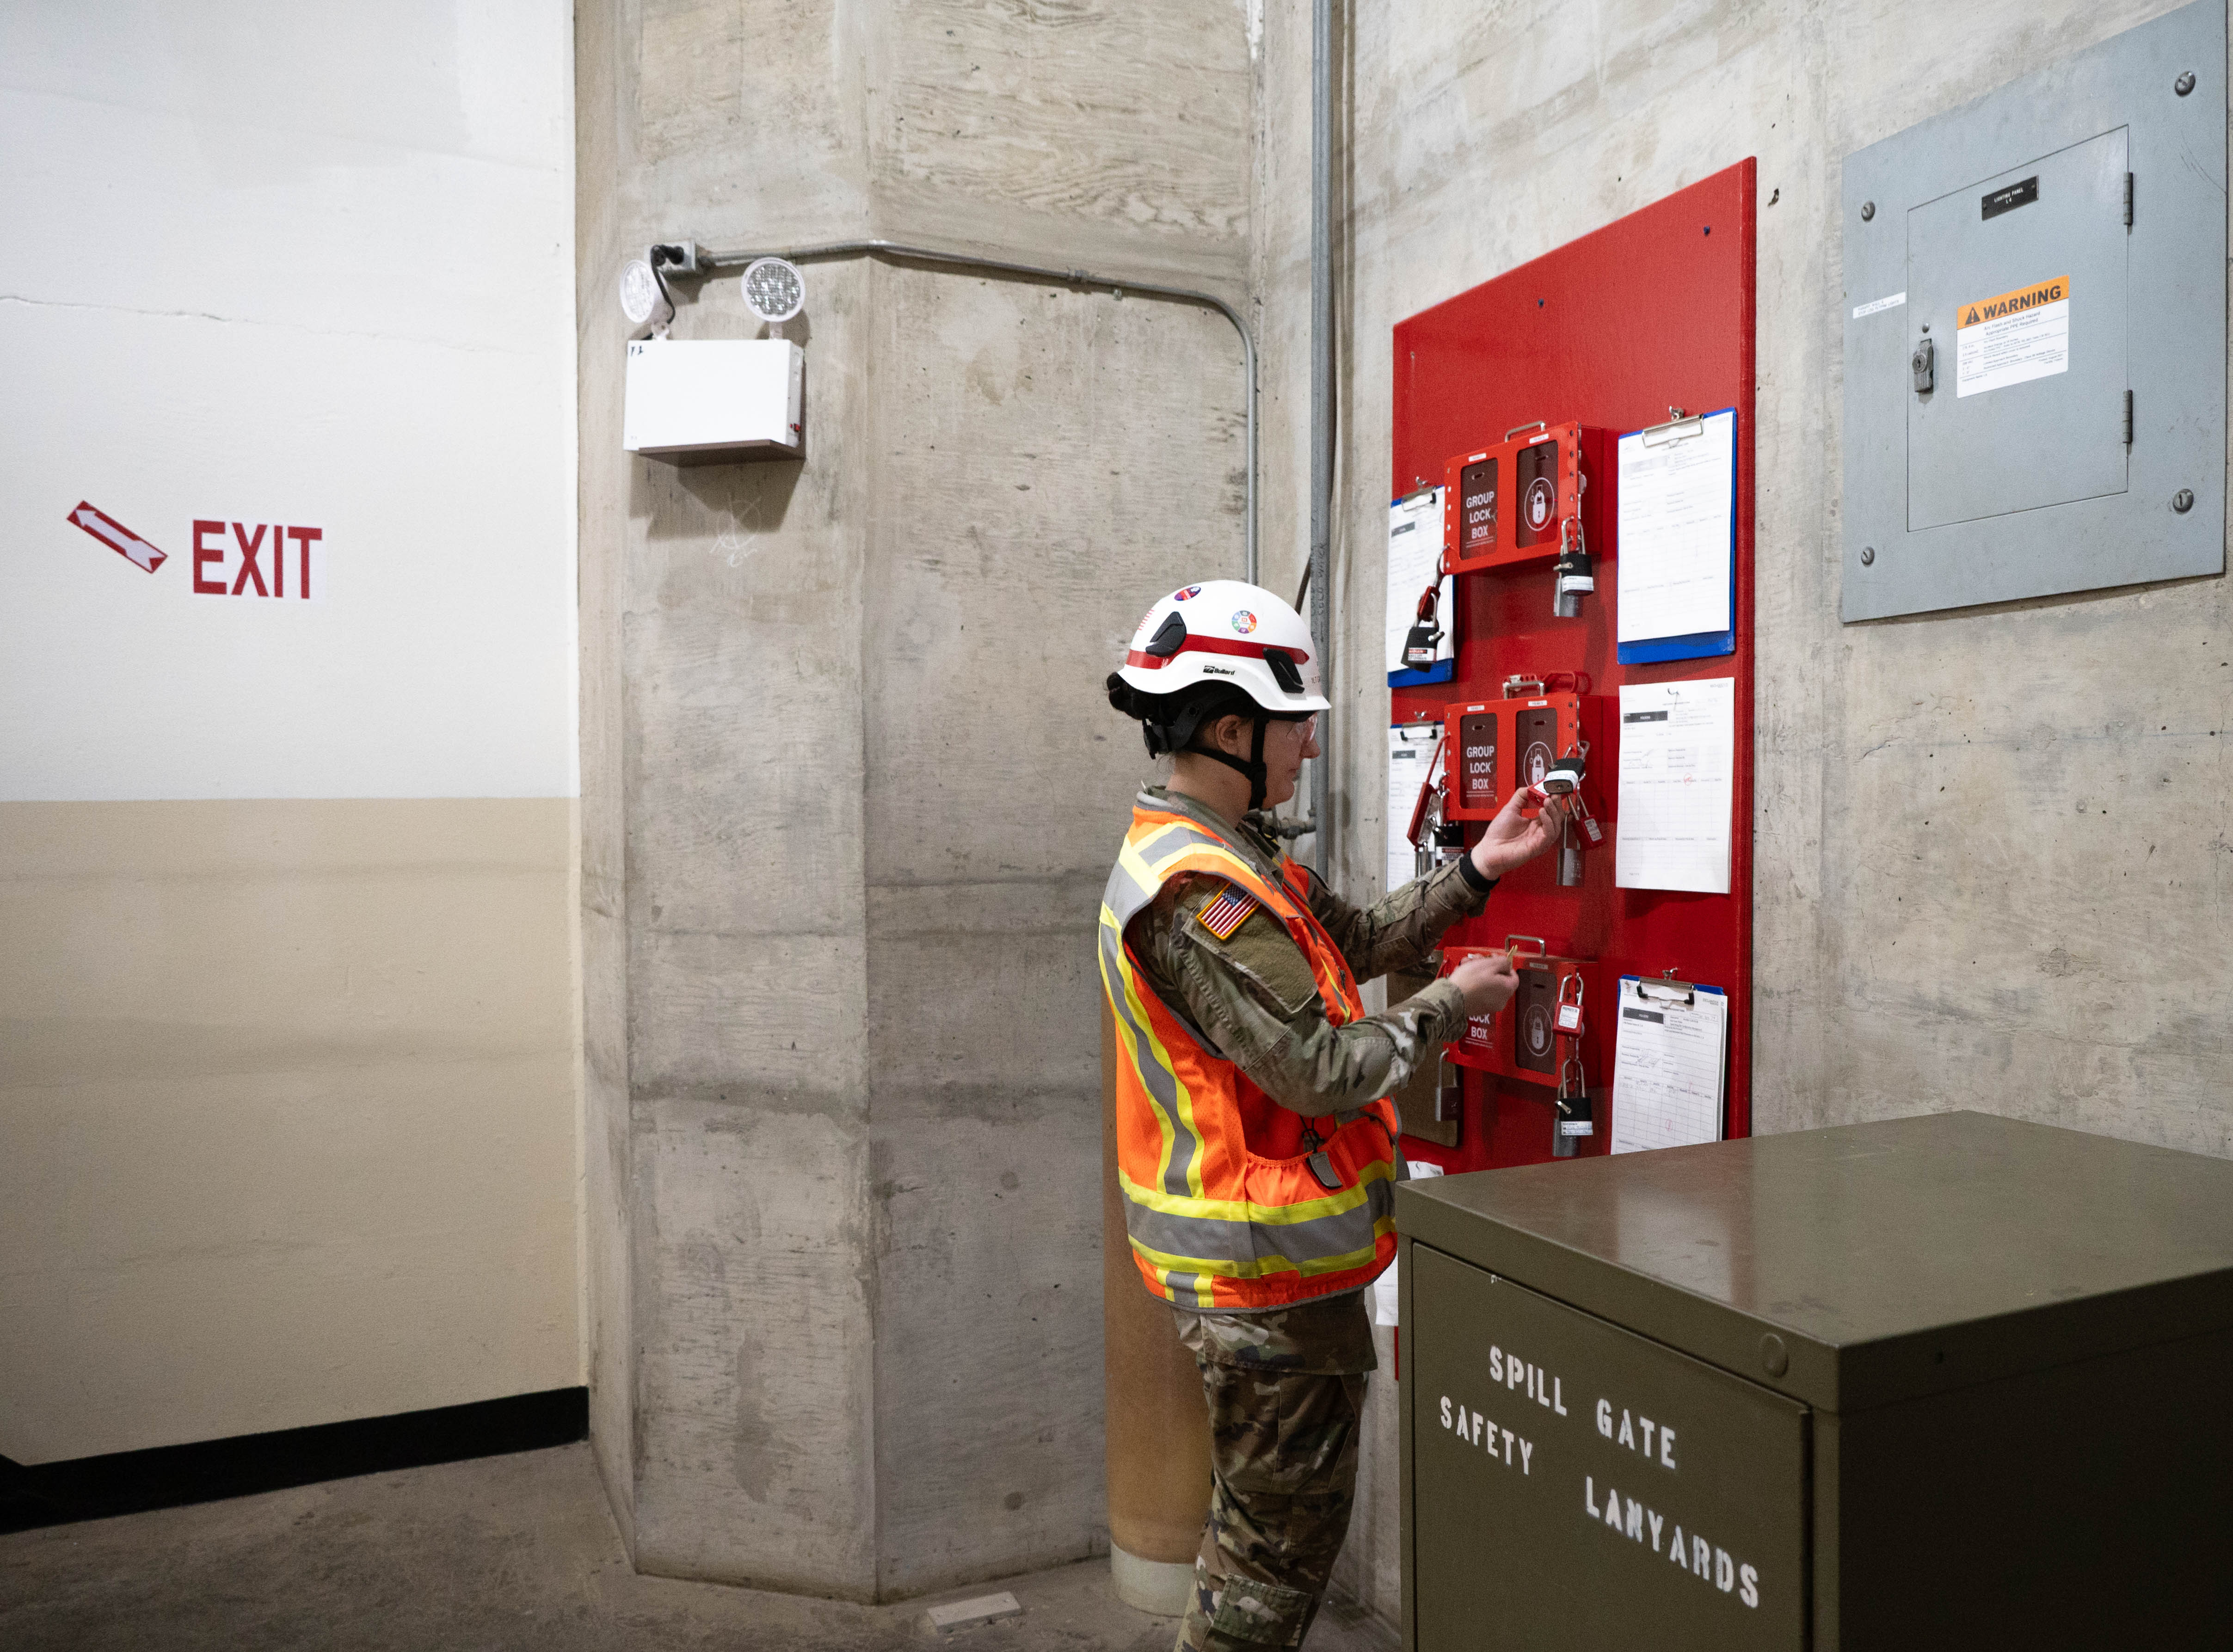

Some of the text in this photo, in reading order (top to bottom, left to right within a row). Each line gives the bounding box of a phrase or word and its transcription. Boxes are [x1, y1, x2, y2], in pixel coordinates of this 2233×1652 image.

[2012, 187, 2023, 196] PANEL
[1983, 285, 2061, 320] WARNING
[1466, 491, 1495, 509] GROUP
[1469, 508, 1491, 524] LOCK
[1471, 525, 1489, 539] BOX
[193, 520, 322, 599] EXIT
[1466, 745, 1495, 758] GROUP
[1470, 762, 1491, 774] LOCK
[1472, 778, 1489, 790] BOX
[1471, 1026, 1488, 1040] BOX
[1489, 1345, 1676, 1469] SPILL GATE
[1440, 1395, 1758, 1608] SAFETY LANYARDS
